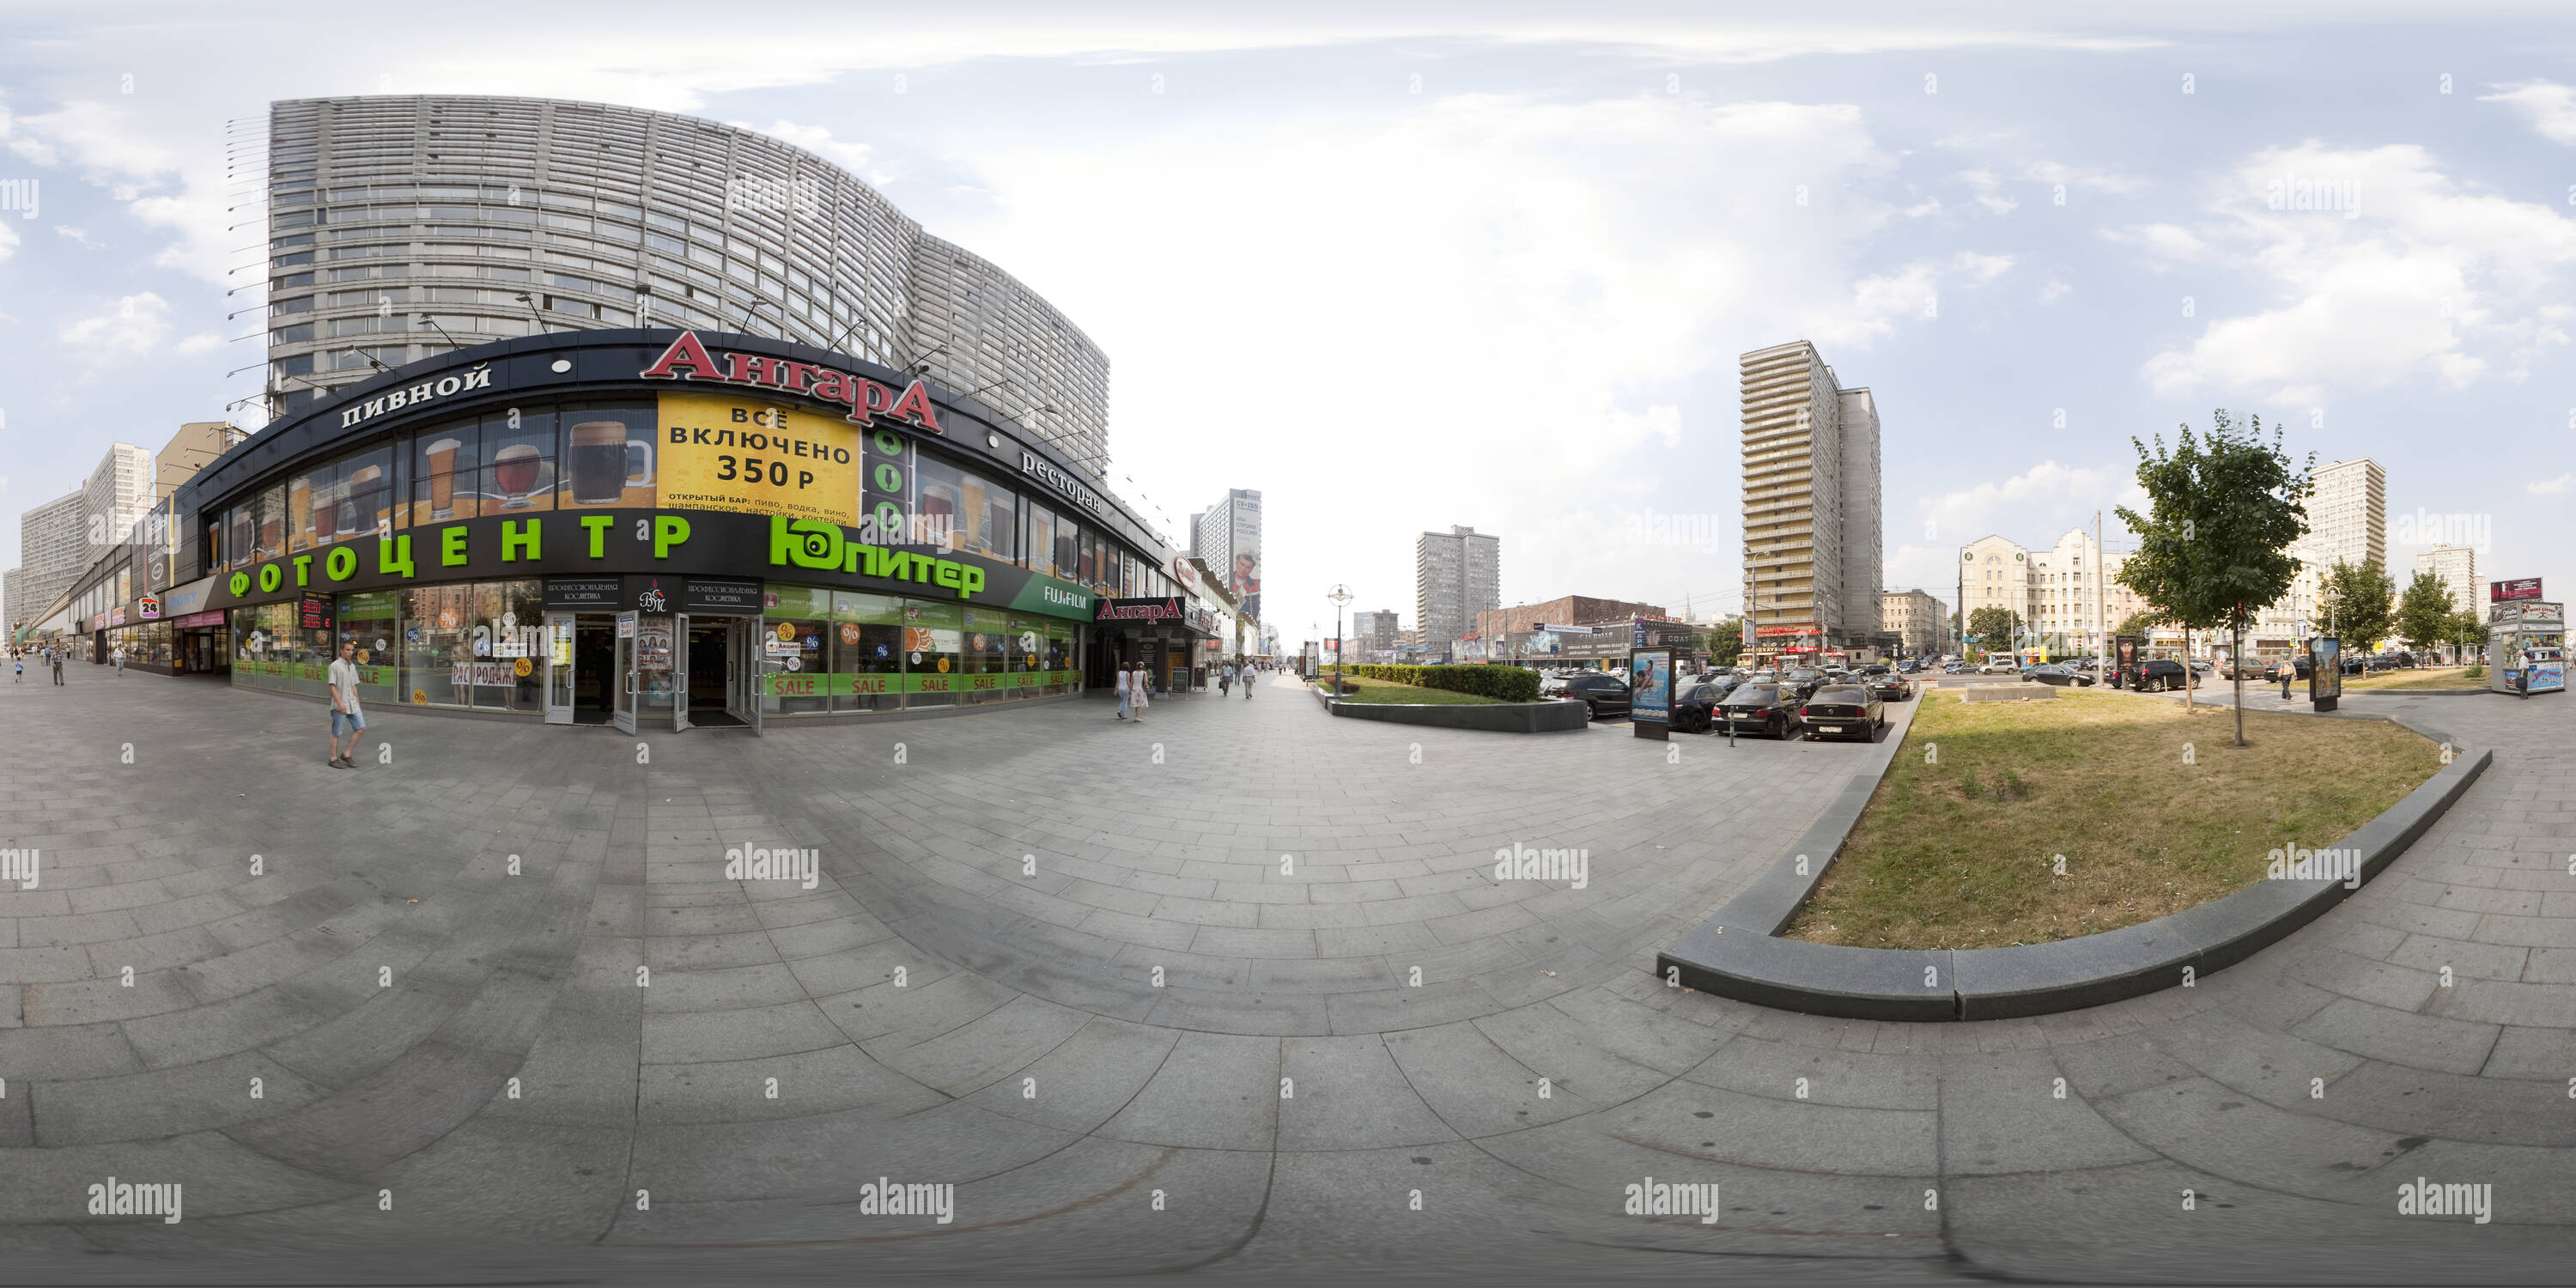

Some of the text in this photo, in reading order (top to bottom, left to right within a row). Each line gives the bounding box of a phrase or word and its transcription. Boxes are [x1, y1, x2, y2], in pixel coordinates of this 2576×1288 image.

[342, 361, 491, 428] ПИВНОЙ
[670, 427, 850, 465] ВКЛЮЧЕНО
[717, 454, 788, 488] 350
[1020, 451, 1102, 513] ресторан
[669, 493, 726, 502] ОТКРЫТЫЙ
[755, 499, 784, 510] пиво,
[787, 502, 820, 514] водка,
[824, 508, 850, 519] вино,
[769, 515, 986, 599] Юпитер
[142, 603, 158, 613] 24
[172, 591, 197, 609] SONY
[265, 665, 283, 677] SALE
[1051, 673, 1065, 683] SALE
[775, 680, 815, 696] SALE
[852, 680, 886, 694] SALE
[921, 679, 949, 692] SALE
[974, 678, 996, 690] SALE
